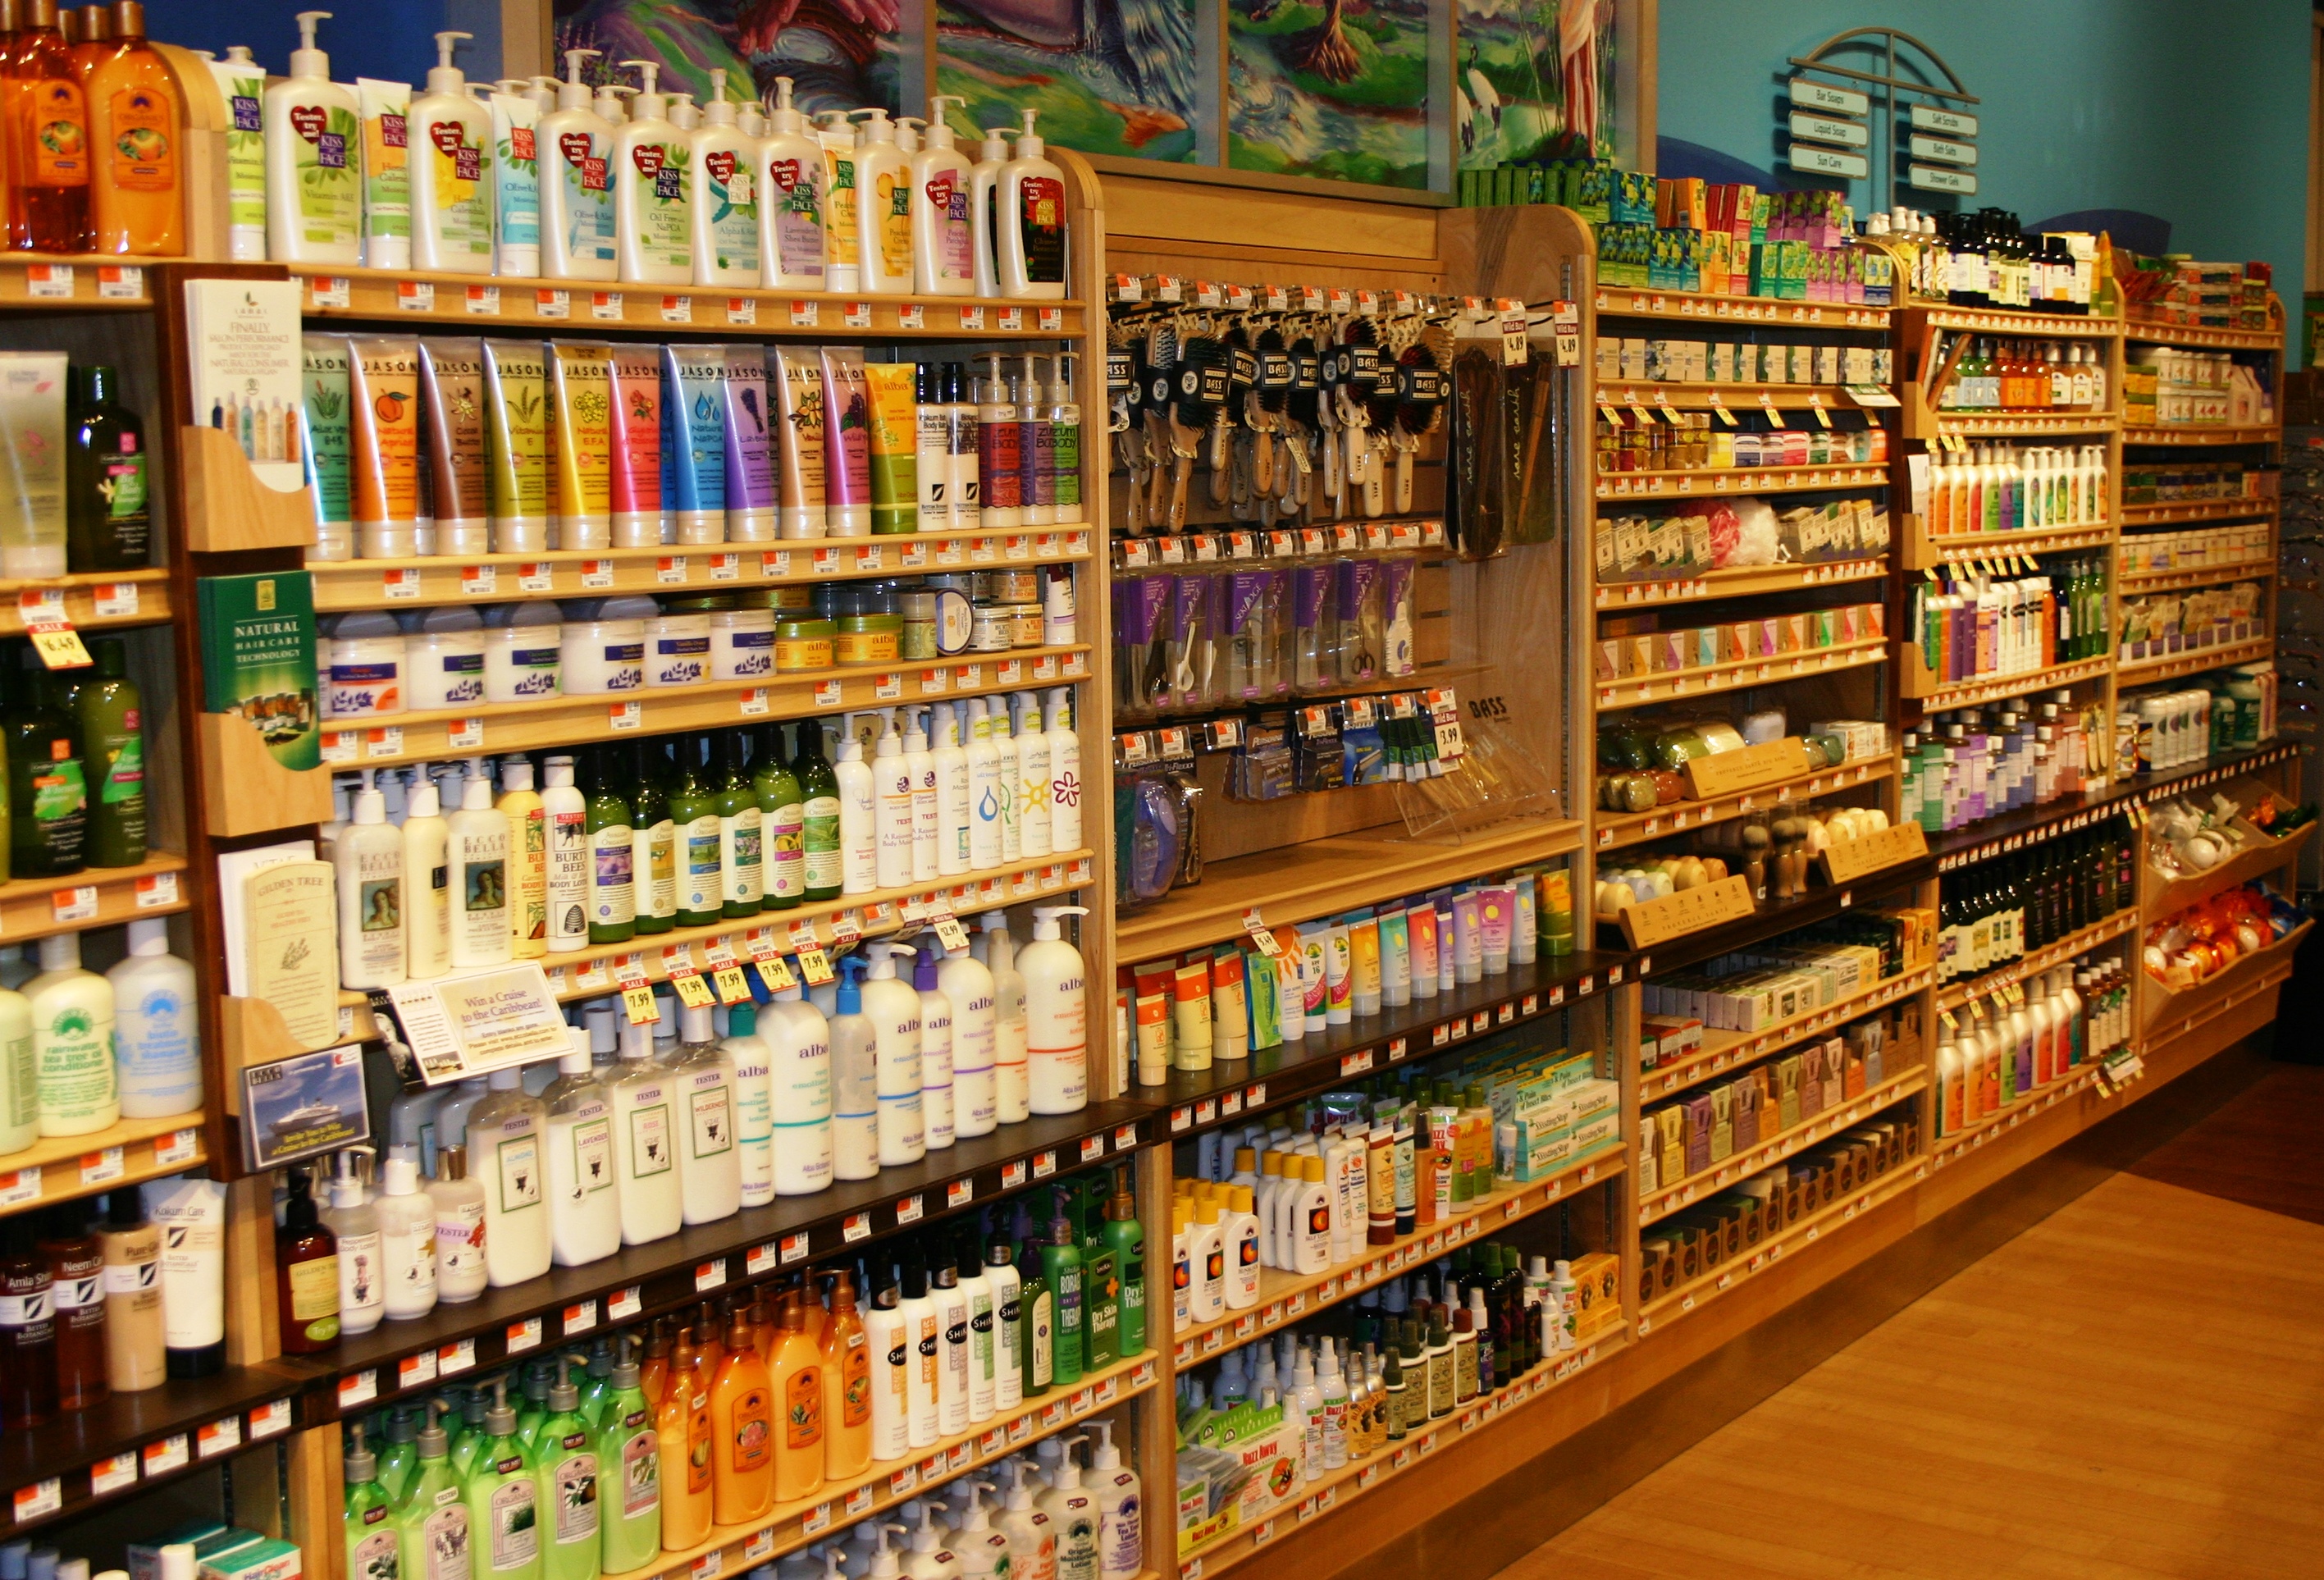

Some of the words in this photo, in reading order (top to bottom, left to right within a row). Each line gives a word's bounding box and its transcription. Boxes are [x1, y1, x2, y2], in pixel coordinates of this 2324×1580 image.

[235, 96, 258, 111] KISS
[1816, 89, 1825, 101] Bar
[1827, 92, 1844, 106] Soaps
[236, 117, 261, 131] FACE
[383, 116, 405, 127] KISS
[514, 130, 532, 141] KISS
[1814, 121, 1831, 136] Liquid
[1832, 125, 1846, 139] Soap
[322, 135, 343, 148] KISS
[385, 134, 407, 147] FACE
[458, 148, 478, 161] KISS
[515, 147, 536, 159] FACE
[321, 153, 345, 167] FACE
[585, 160, 605, 171] KISS
[1817, 155, 1828, 167] Sun
[1829, 157, 1842, 169] Care
[838, 162, 854, 171] KISS
[457, 167, 480, 180] FACE
[659, 169, 678, 181] KISS
[584, 176, 606, 188] FACE
[731, 176, 749, 185] KISS
[839, 177, 854, 187] FACE
[657, 186, 680, 199] FACE
[793, 185, 811, 196] KISS
[893, 190, 907, 199] KISS
[730, 192, 751, 203] FACE
[950, 194, 966, 205] KISS
[792, 201, 813, 212] FACE
[893, 204, 908, 214] FACE
[1037, 200, 1054, 211] KISS
[949, 209, 966, 219] FACE
[1036, 213, 1056, 225] FACE
[1357, 357, 1378, 368] BASS
[1268, 363, 1287, 375] BASS
[1206, 377, 1222, 389] BASS
[1415, 379, 1436, 390] BASS
[35, 622, 66, 632] SALE
[234, 621, 300, 637] NATURAL
[235, 640, 266, 651] HAIR
[269, 636, 301, 646] CARE
[235, 649, 301, 663] TECHNOLOGY
[298, 877, 324, 887] TREE
[840, 934, 857, 943] SALE
[798, 943, 818, 952] SALE
[756, 951, 777, 961] SALE
[716, 960, 735, 970] SALE
[675, 969, 695, 978] SALE
[626, 979, 646, 989] SALE
[465, 996, 487, 1008] Win
[495, 989, 527, 1003] Cruise
[461, 1013, 473, 1024] to
[473, 1008, 490, 1021] the
[491, 998, 543, 1018] Caribbean!
[799, 1043, 829, 1059] alba
[737, 1066, 769, 1078] alba
[695, 1072, 721, 1085] TESTER
[636, 1089, 662, 1102] TESTER
[578, 1104, 604, 1117] TESTER
[504, 1117, 530, 1131] TESTER
[64, 1259, 92, 1272] Neem
[8, 1274, 34, 1289] Amla
[1125, 1285, 1139, 1298] Dry
[1092, 1311, 1103, 1324] Dry
[1104, 1304, 1117, 1317] Skin
[1093, 1315, 1116, 1334] Therapy
